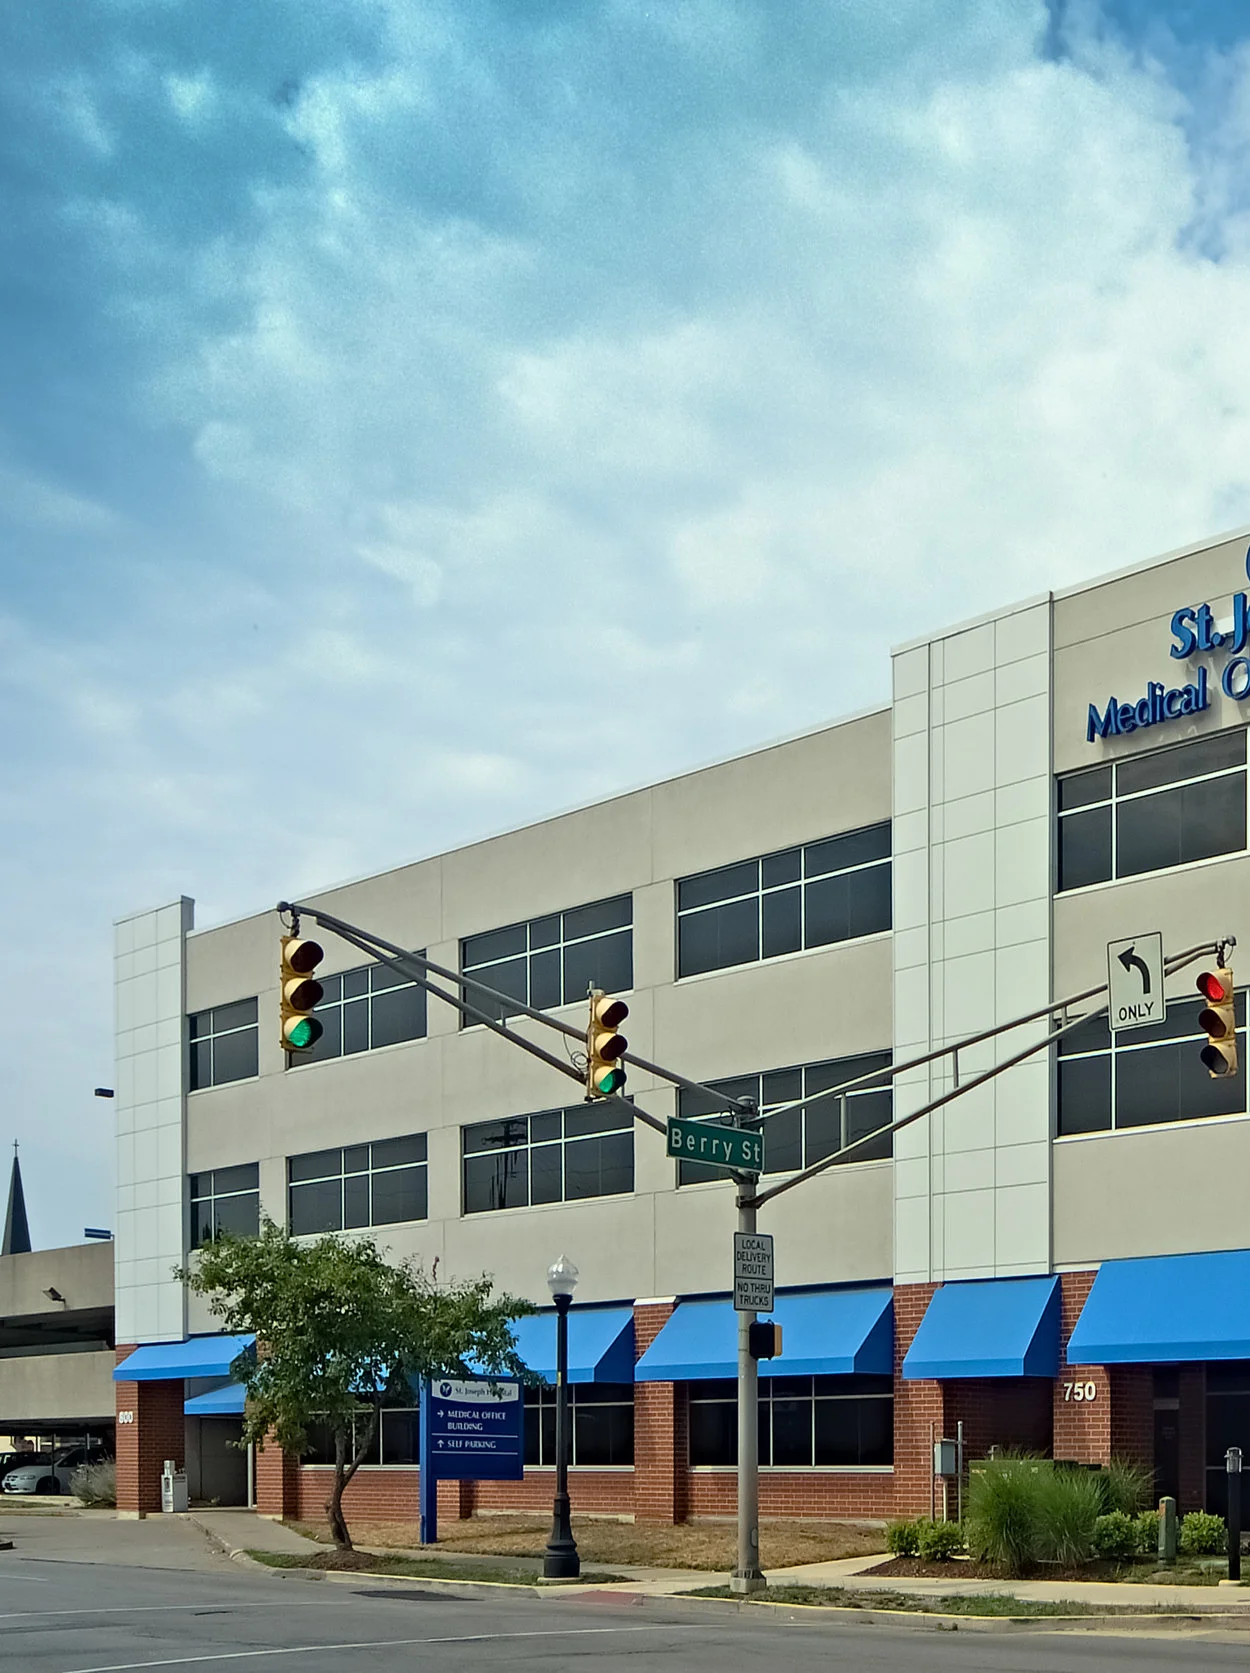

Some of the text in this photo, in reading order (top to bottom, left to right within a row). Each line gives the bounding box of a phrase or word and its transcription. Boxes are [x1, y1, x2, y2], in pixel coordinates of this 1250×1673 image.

[1170, 604, 1225, 660] St.
[1086, 666, 1211, 743] Medical
[1118, 1001, 1155, 1021] ONLY
[671, 1128, 760, 1163] Berry St
[741, 1239, 766, 1251] LOCAL
[736, 1250, 771, 1263] DELIVERY
[742, 1263, 766, 1275] ROUTE
[737, 1282, 771, 1294] NO THRU
[740, 1294, 769, 1306] TRUCKS
[465, 1387, 485, 1397] Joseph
[1063, 1381, 1096, 1401] 750
[447, 1410, 506, 1420] MEDICAL OFFICE
[447, 1422, 483, 1431] BUILDING
[447, 1440, 496, 1449] SELF PARKING
